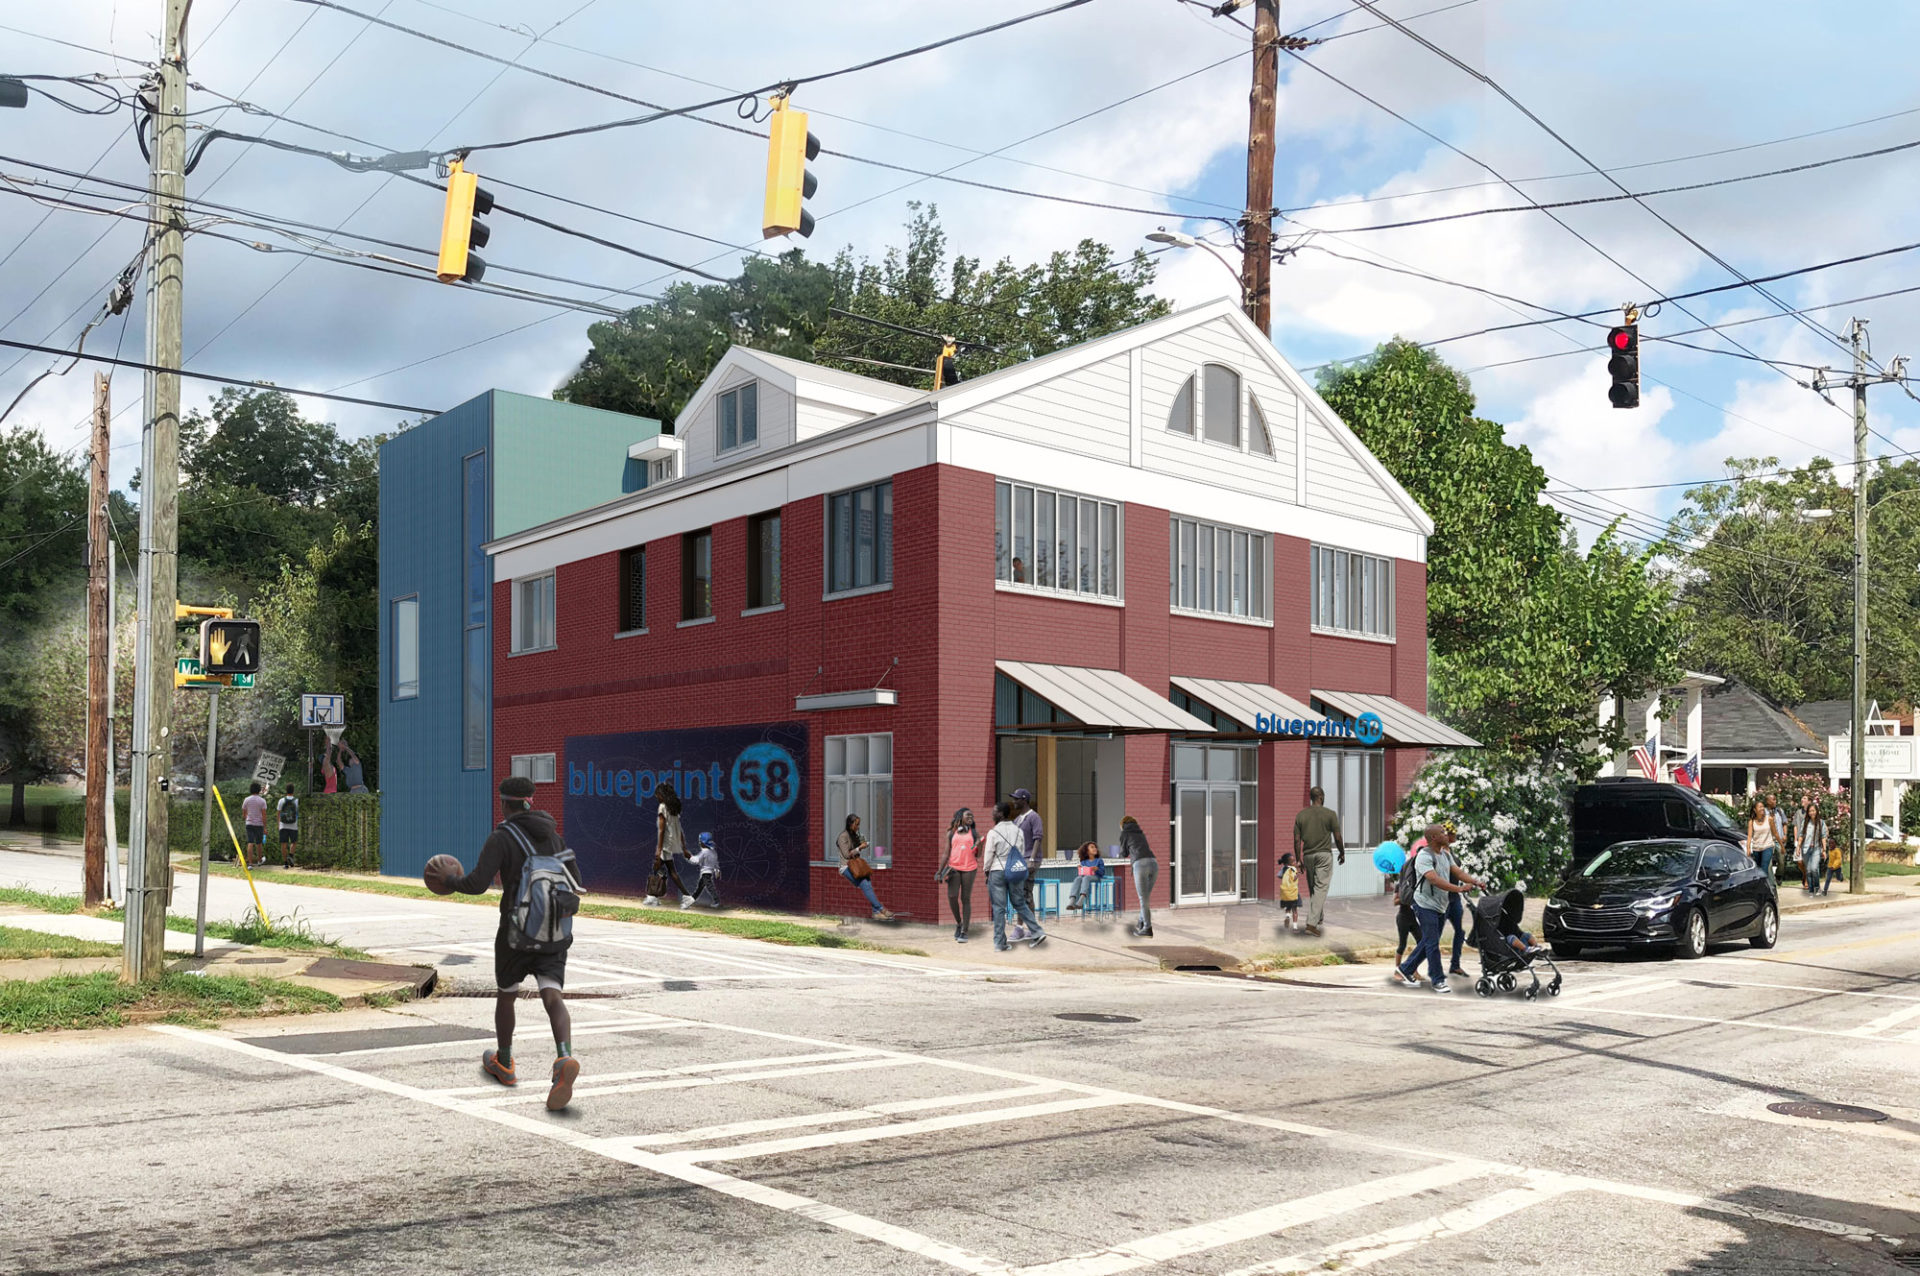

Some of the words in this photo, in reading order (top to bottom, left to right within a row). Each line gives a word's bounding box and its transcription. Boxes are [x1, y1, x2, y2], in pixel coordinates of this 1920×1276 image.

[1256, 712, 1352, 738] blueprint
[1358, 719, 1380, 737] 58
[257, 766, 277, 781] 25
[262, 761, 279, 769] LIMIT
[568, 760, 725, 807] blueprint
[737, 760, 791, 803] 58
